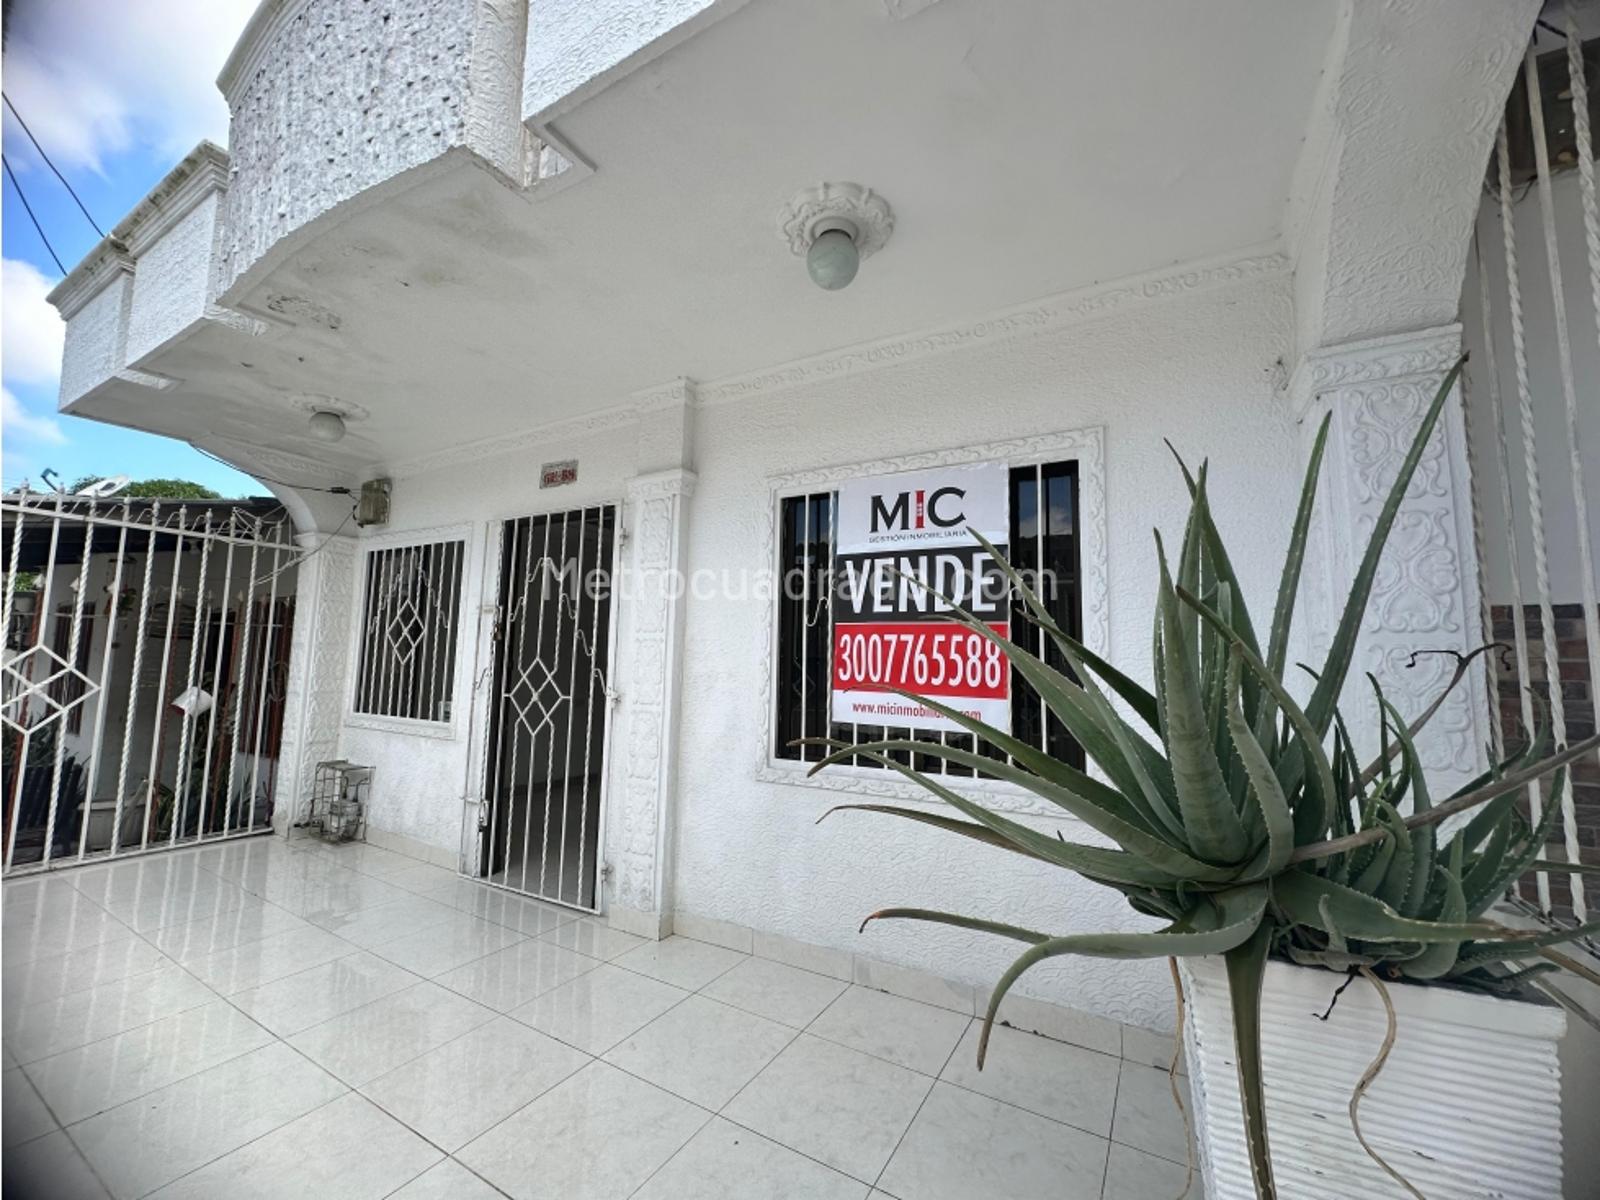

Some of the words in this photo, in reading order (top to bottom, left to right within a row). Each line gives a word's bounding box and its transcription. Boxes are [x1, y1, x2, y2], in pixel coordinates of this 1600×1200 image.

[870, 486, 967, 533] MIC
[846, 552, 997, 614] VENDE
[838, 633, 1001, 689] 3007765588
